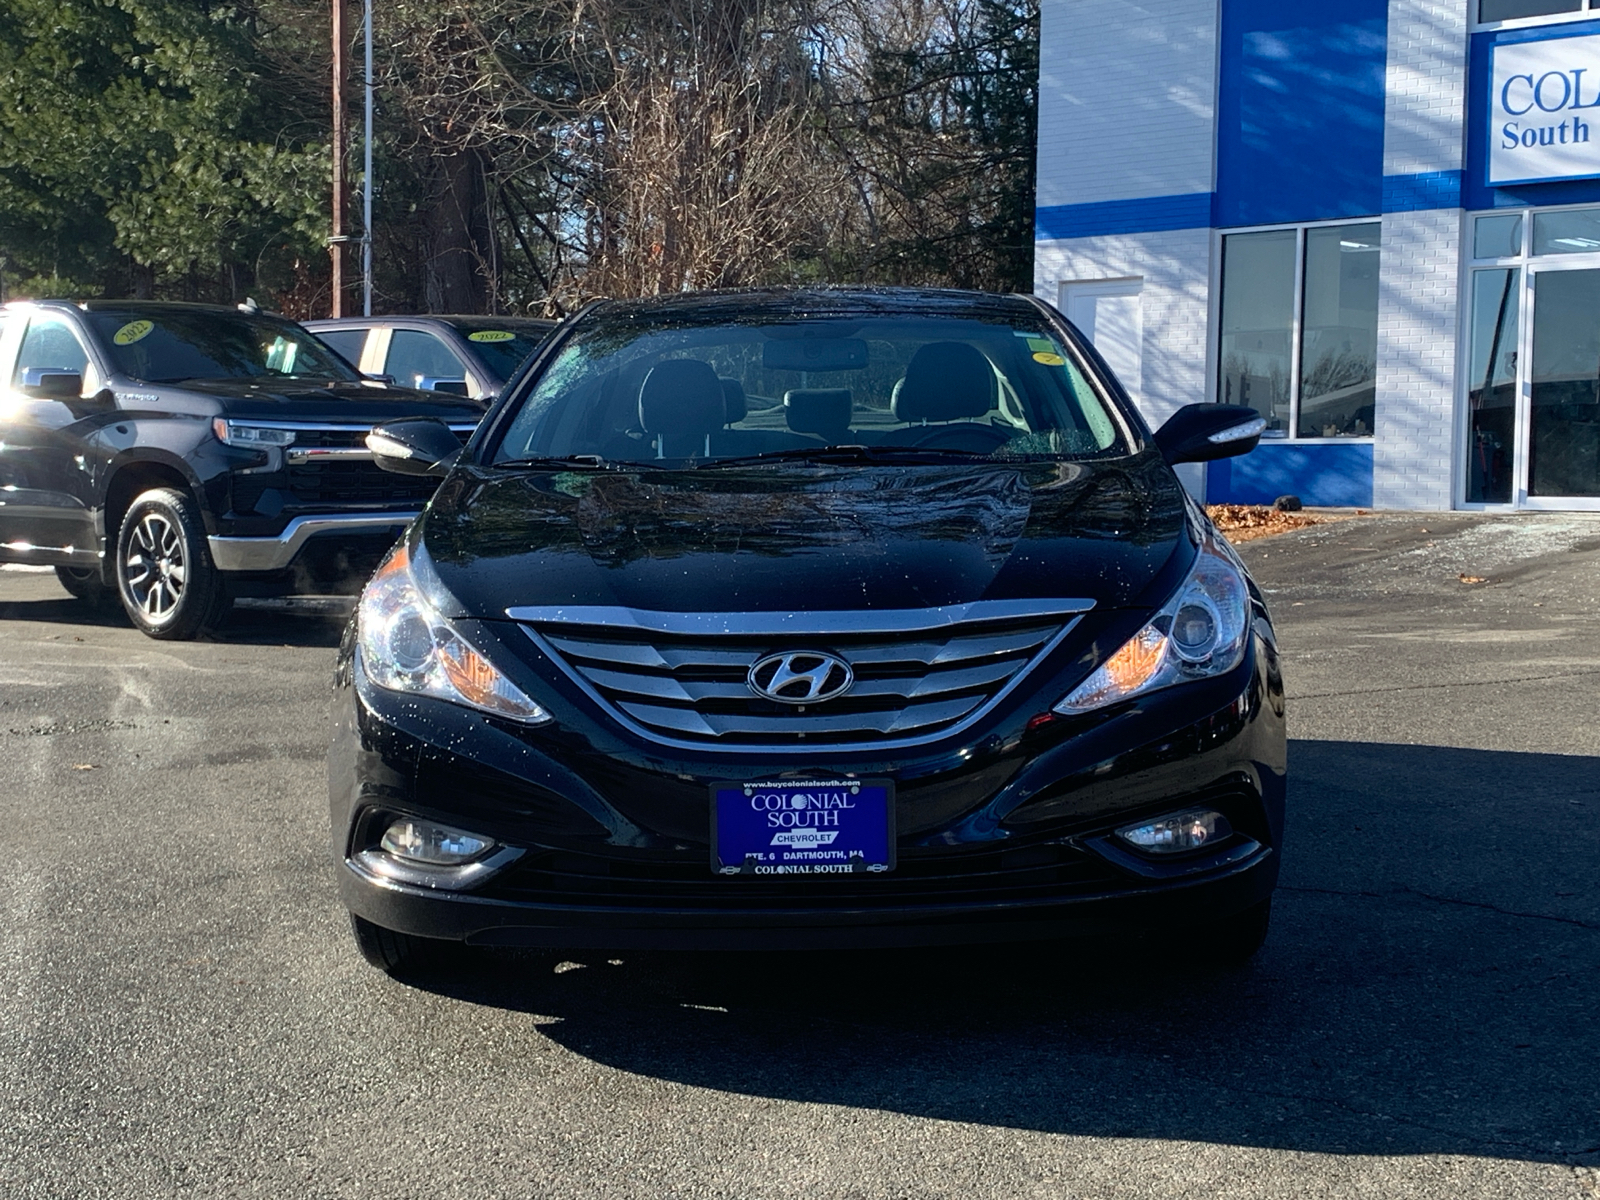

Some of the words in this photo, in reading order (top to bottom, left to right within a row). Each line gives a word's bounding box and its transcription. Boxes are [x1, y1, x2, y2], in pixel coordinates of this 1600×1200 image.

[1502, 116, 1590, 149] South
[122, 322, 148, 341] 2022
[743, 780, 861, 788] www.buycolonialsouth.com
[751, 793, 855, 811] COLONIAL
[768, 811, 839, 827] SOUTH
[777, 834, 832, 843] CHEVROLET
[769, 852, 775, 860] 6
[783, 850, 847, 860] DARTMOUTH,
[754, 865, 812, 874] COLONIAL
[814, 864, 853, 873] SOUTH
